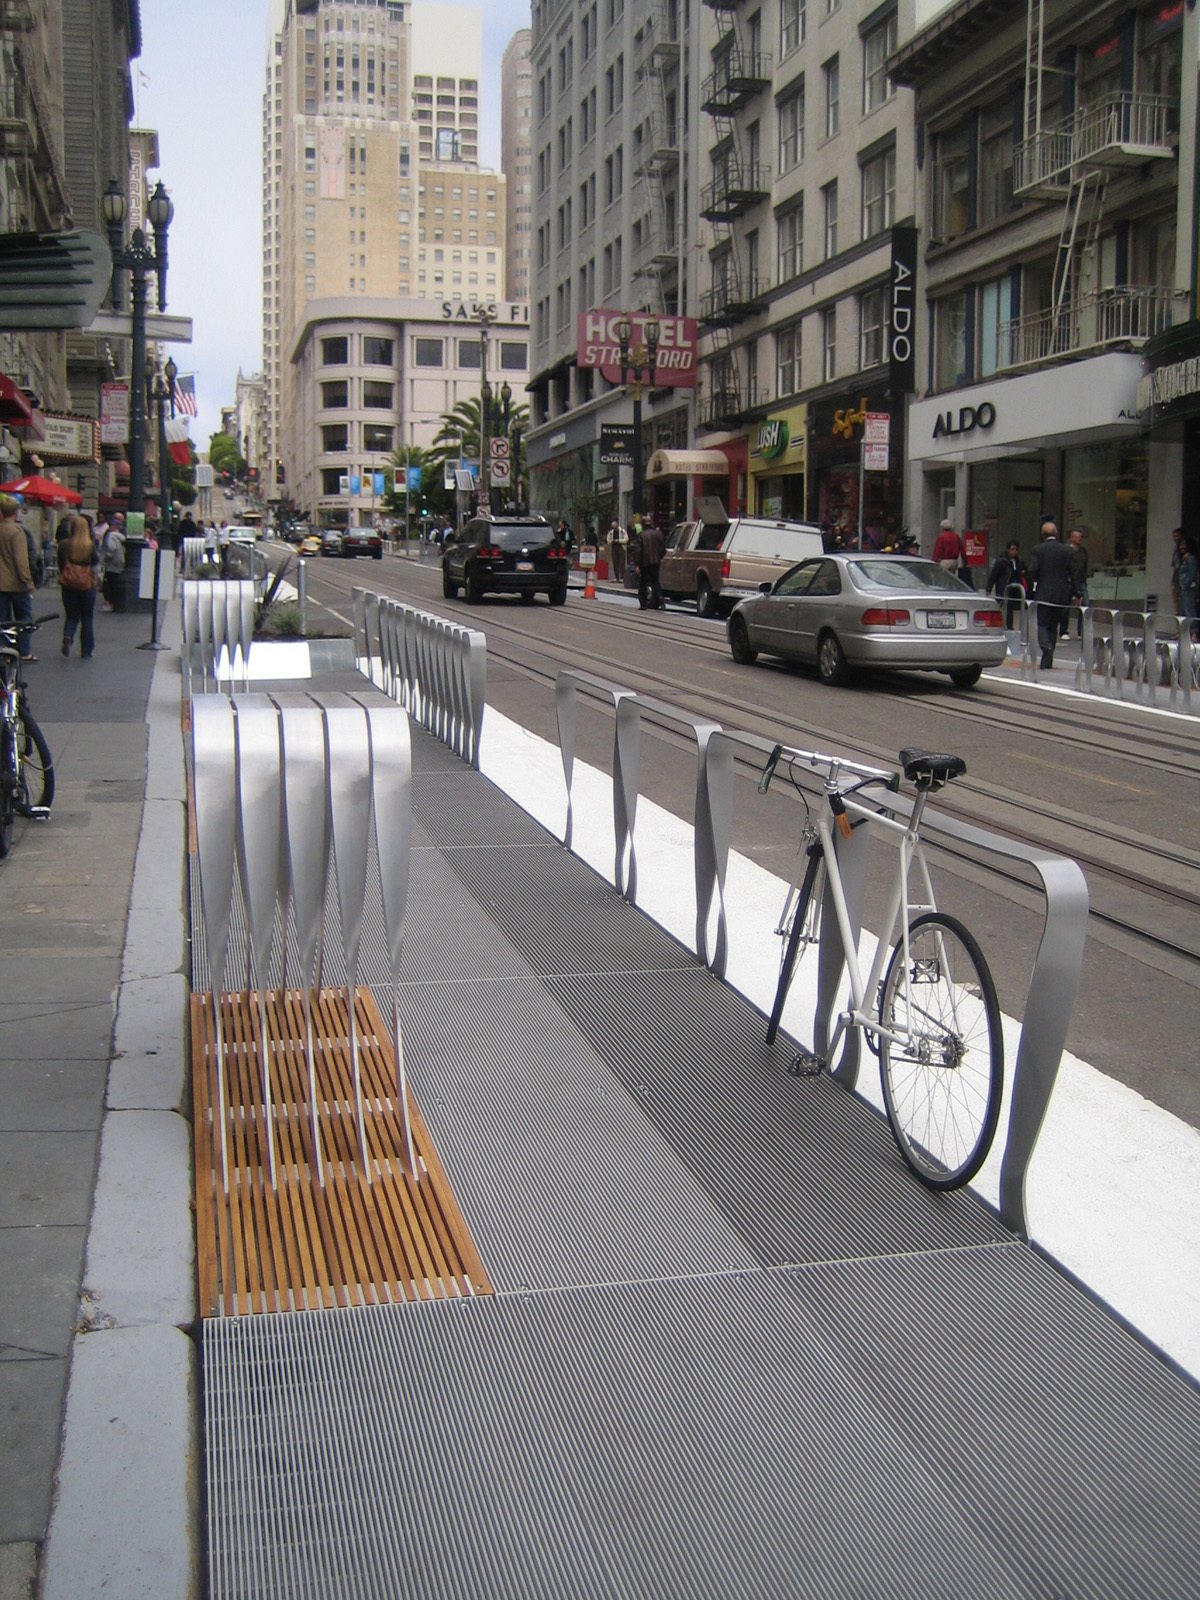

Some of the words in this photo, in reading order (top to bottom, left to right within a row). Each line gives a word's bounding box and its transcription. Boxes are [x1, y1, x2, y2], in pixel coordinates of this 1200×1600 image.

[892, 259, 911, 362] ALDO
[585, 314, 693, 348] HOTEL
[585, 345, 694, 370] STRORD
[757, 420, 780, 449] LUSH
[932, 401, 996, 439] ALDO
